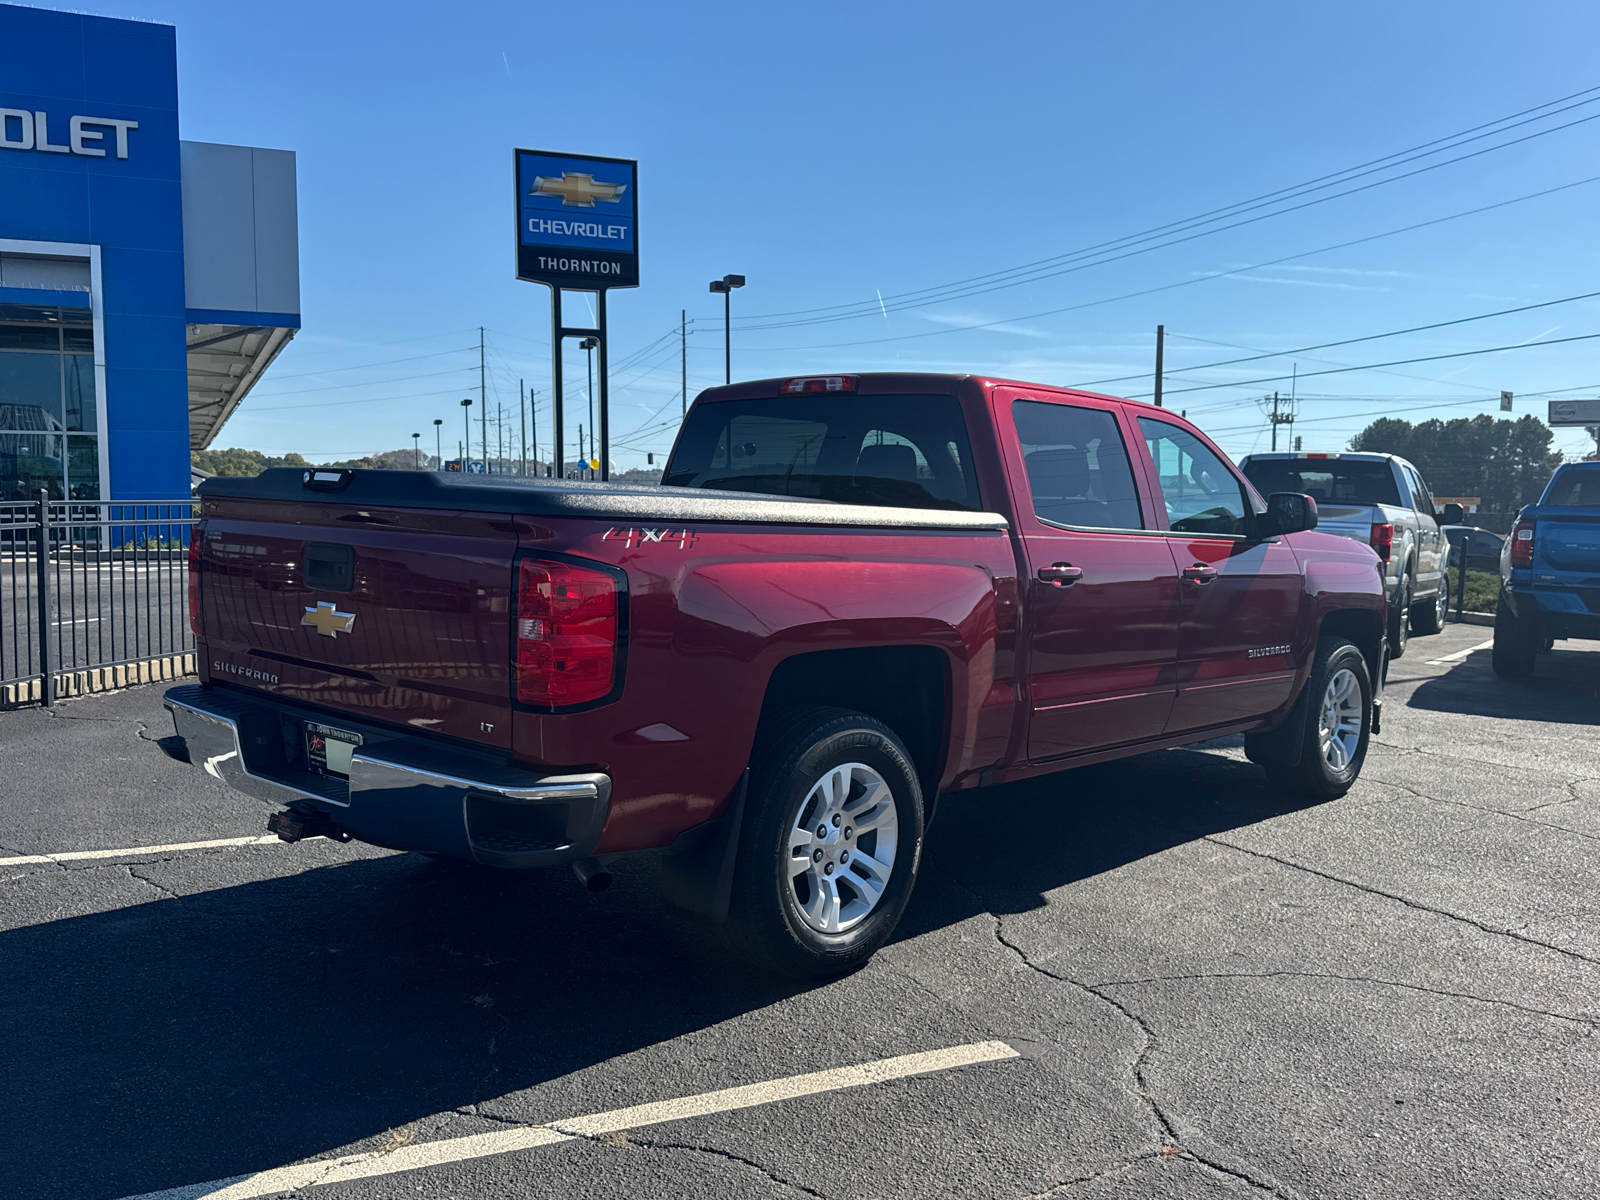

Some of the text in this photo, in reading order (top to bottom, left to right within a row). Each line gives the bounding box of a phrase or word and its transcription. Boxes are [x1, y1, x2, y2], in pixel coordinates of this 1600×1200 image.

[528, 218, 628, 240] CHEVROLET
[538, 256, 621, 275] THORNTON
[1248, 644, 1291, 658] SILVERADO
[213, 660, 279, 684] SILVERADO
[480, 721, 494, 734] LT
